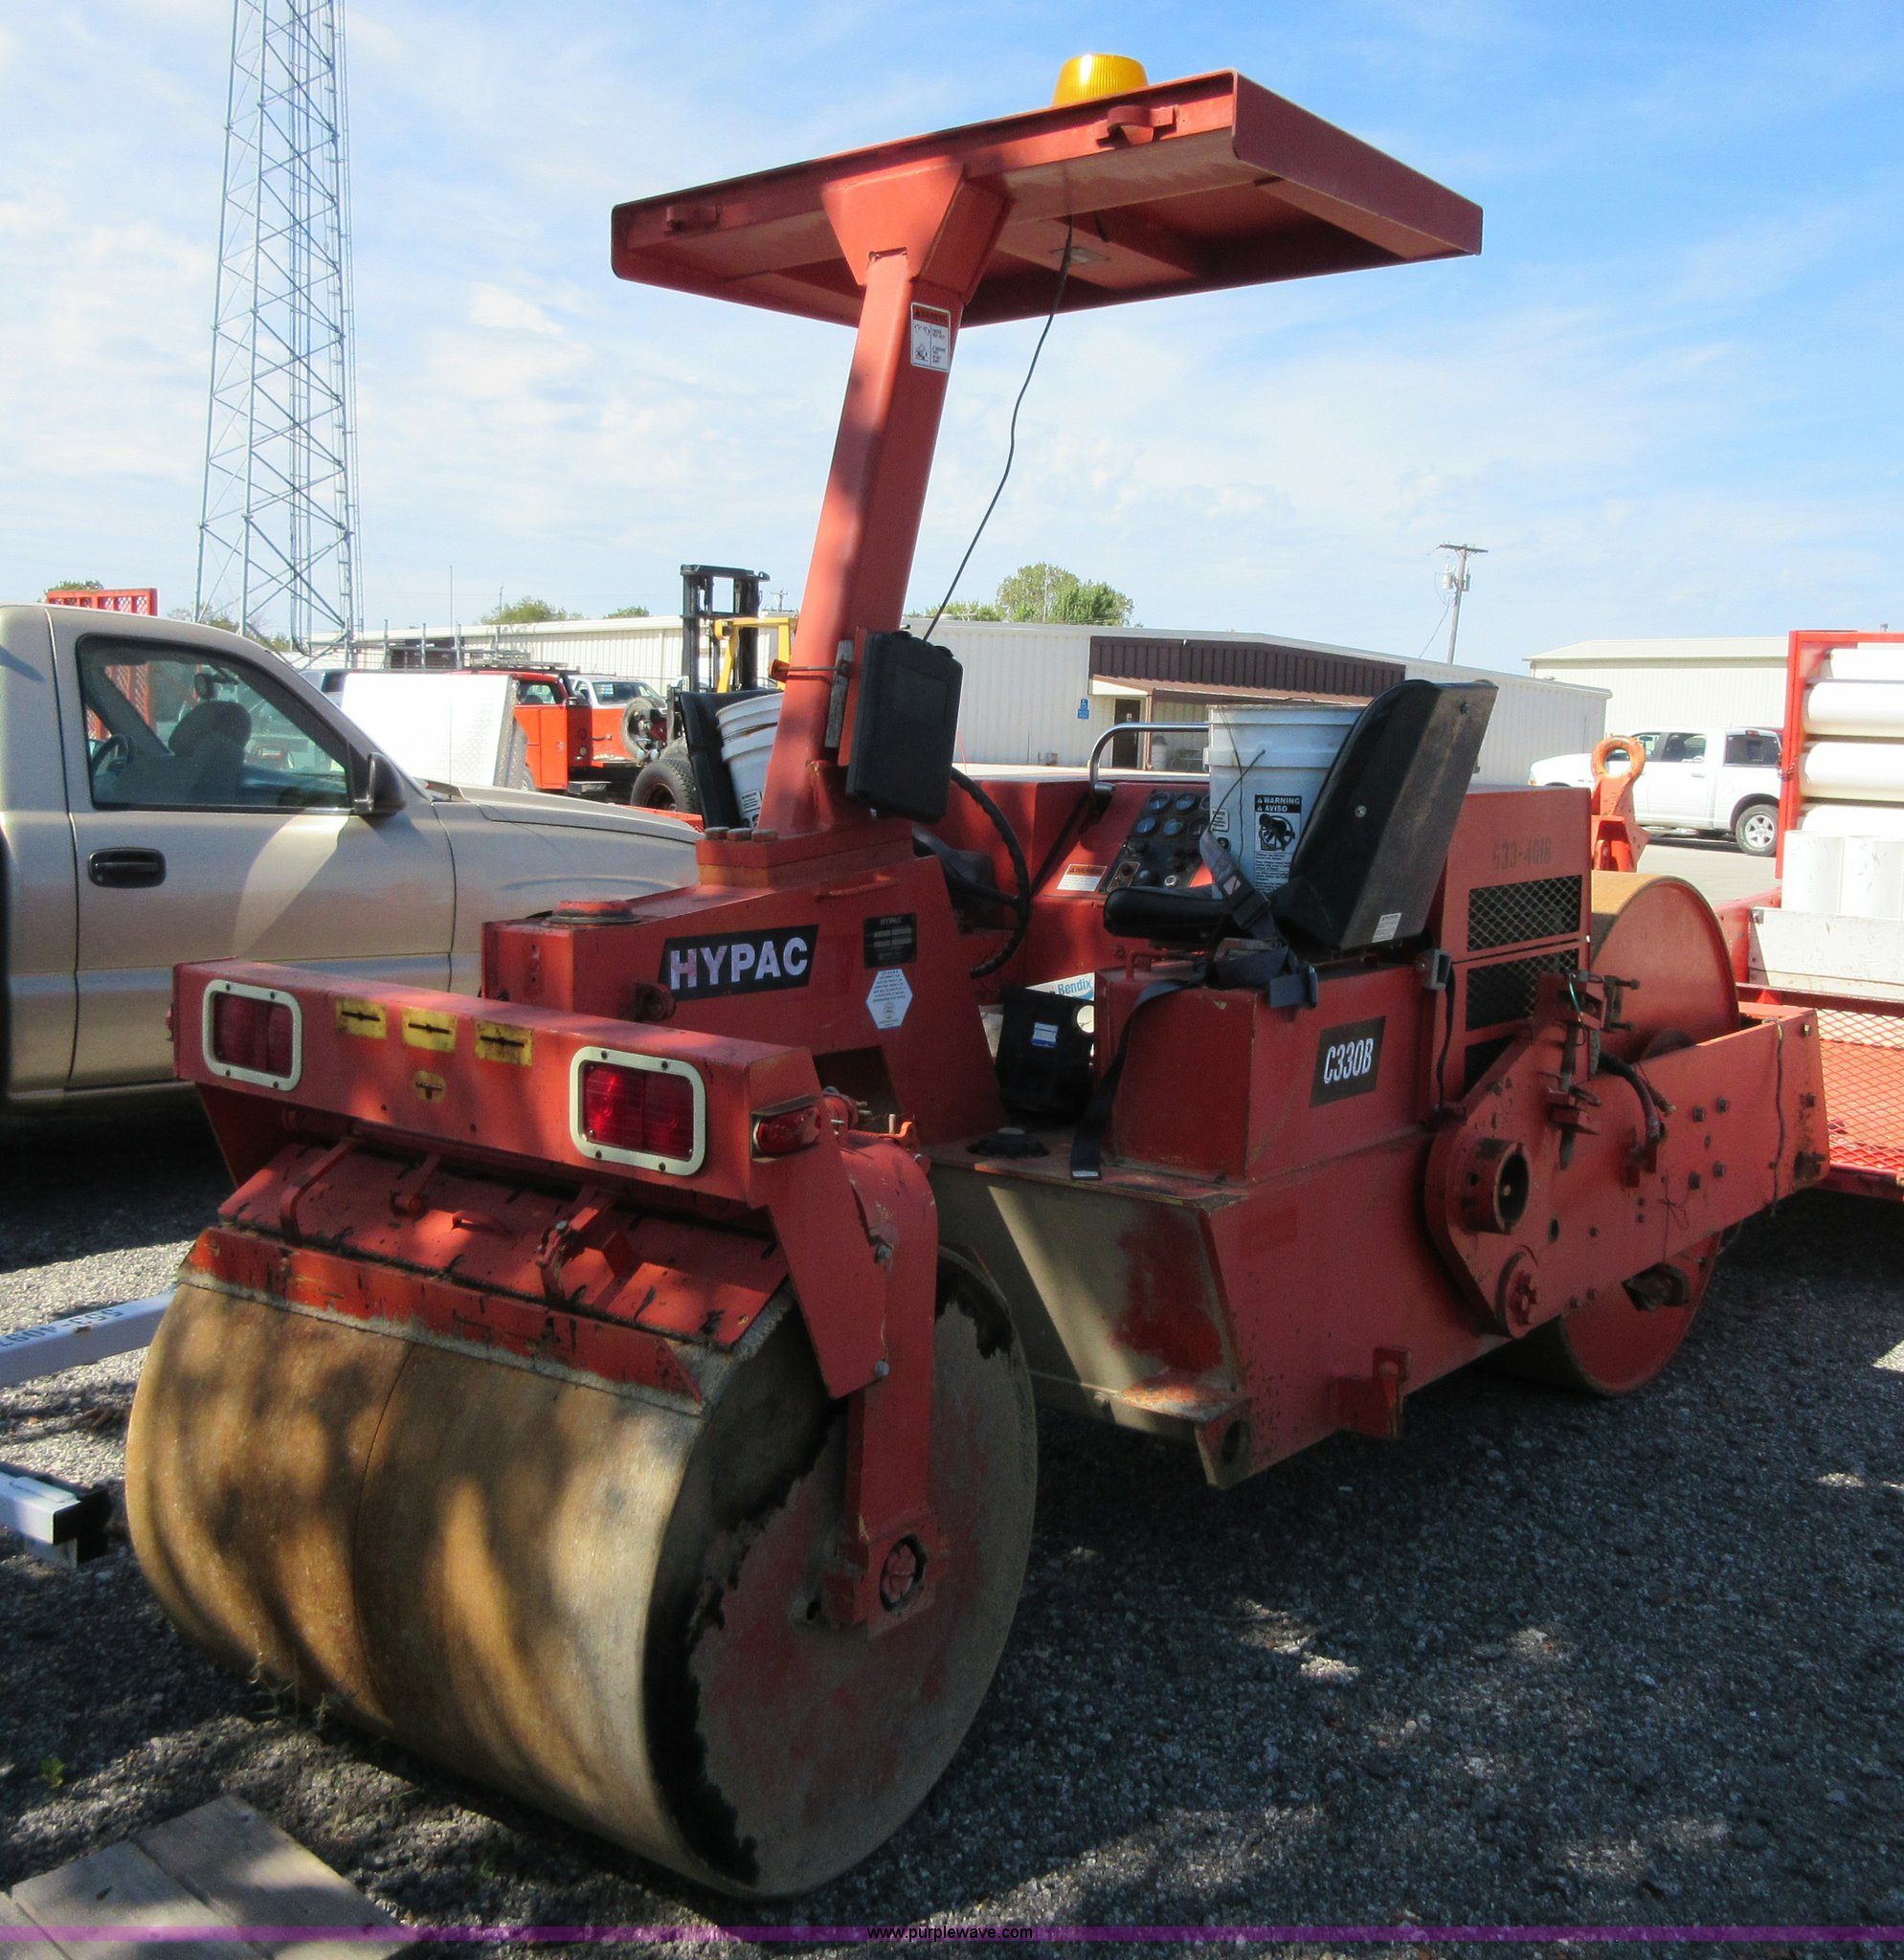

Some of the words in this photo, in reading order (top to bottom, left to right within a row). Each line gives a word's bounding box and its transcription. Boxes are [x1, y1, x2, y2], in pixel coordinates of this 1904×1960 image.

[1264, 796, 1300, 805] WARNING
[670, 937, 808, 991] HYPAC
[1057, 978, 1092, 995] Bendix
[1324, 1037, 1374, 1084] C330B
